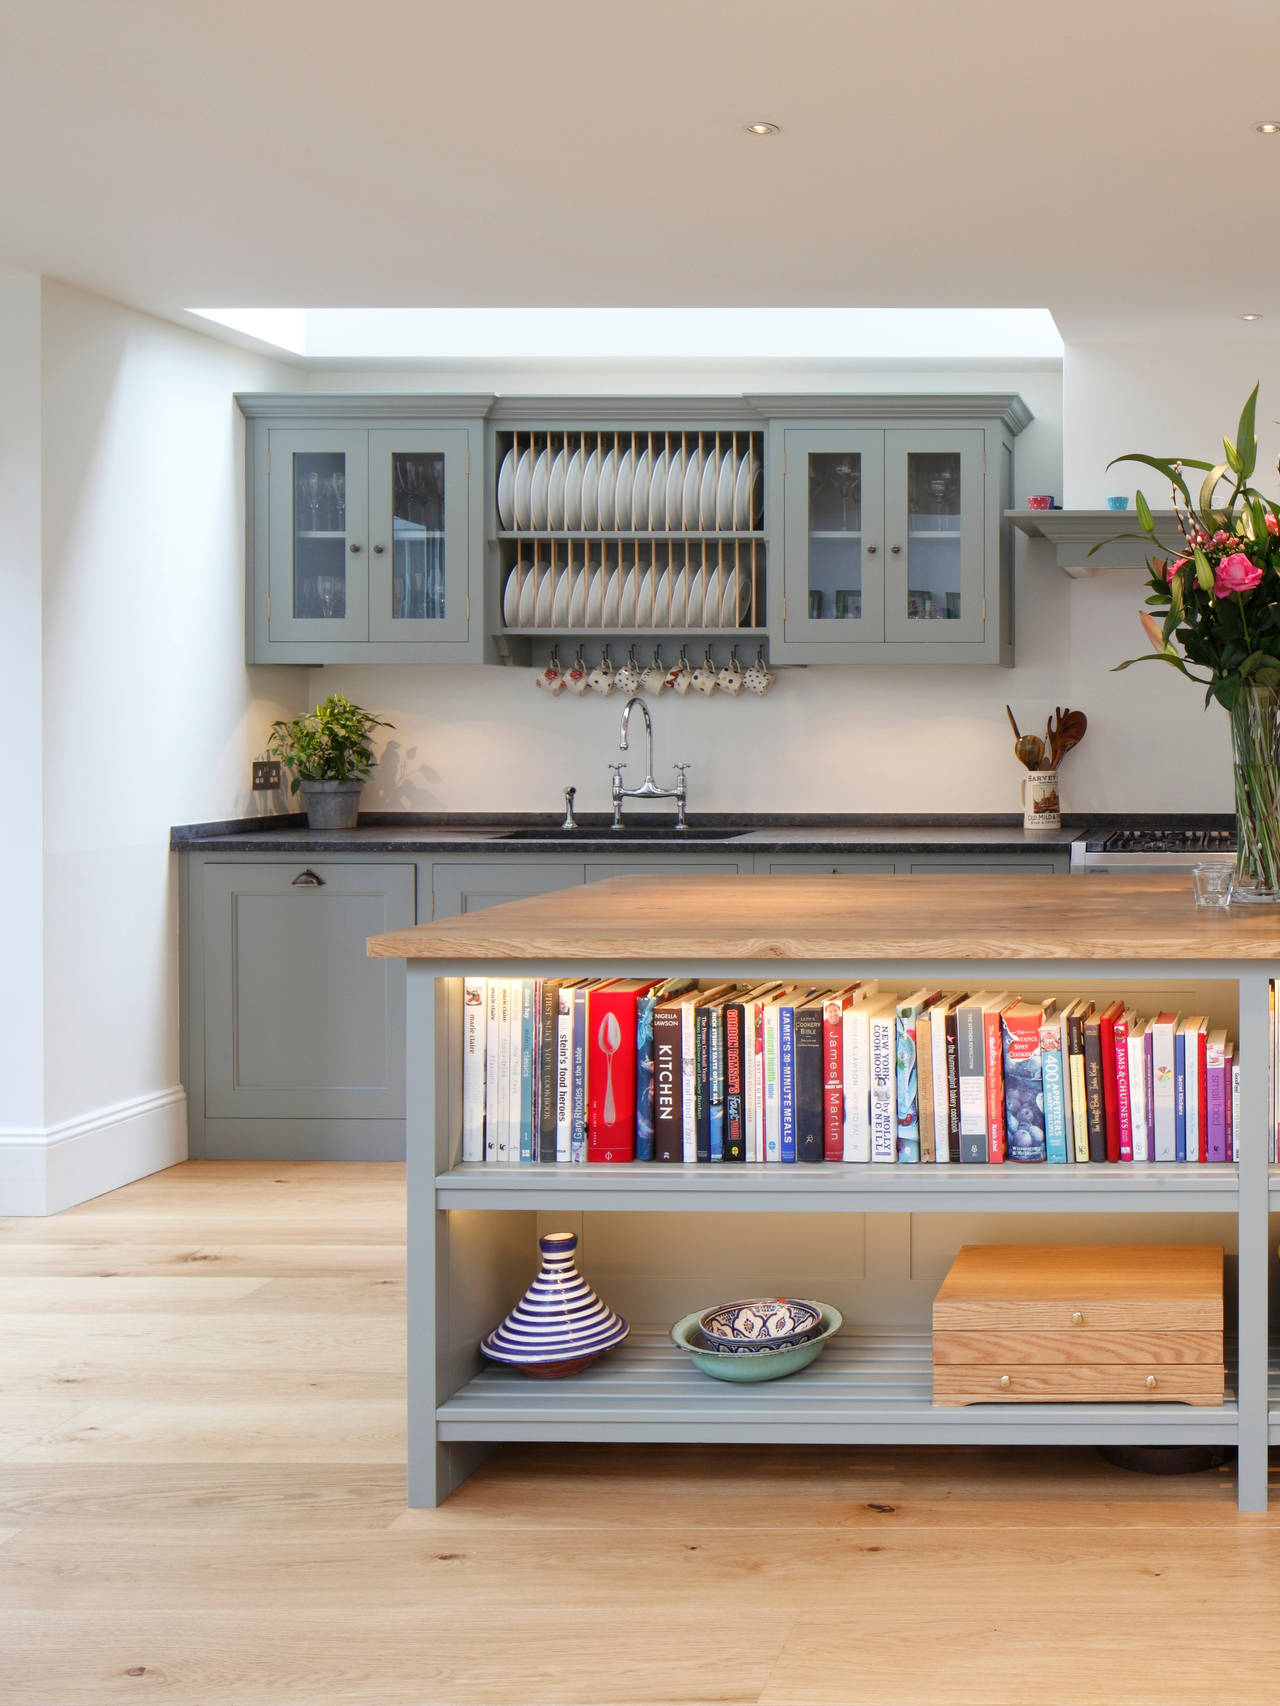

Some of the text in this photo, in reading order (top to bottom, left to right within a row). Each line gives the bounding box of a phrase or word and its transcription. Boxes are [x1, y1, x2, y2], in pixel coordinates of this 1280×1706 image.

[523, 1008, 531, 1018] hay
[545, 993, 553, 1016] FIRST
[468, 1014, 477, 1031] marie
[468, 1032, 477, 1055] claire
[728, 1009, 740, 1094] GORDON RAMSAY'S
[829, 1031, 837, 1081] James
[874, 1025, 882, 1080] COOKBOOK
[882, 1026, 890, 1080] NEW YORK
[1116, 1047, 1125, 1070] JAMS
[523, 1051, 531, 1078] classics
[559, 1034, 568, 1122] stein's food heroes
[712, 1070, 718, 1079] OF
[782, 1011, 792, 1143] JAMIE'S 30-MINUTE MEALS
[1045, 1056, 1057, 1081] 400
[1116, 1070, 1126, 1078] &
[659, 1044, 673, 1119] KITCHEN
[684, 1079, 692, 1097] real
[545, 1075, 553, 1120] COOKBOOK
[574, 1088, 583, 1118] Rhodes
[684, 1099, 692, 1118] food
[949, 1089, 957, 1107] bakery
[1053, 1084, 1062, 1136] APPETIZERS
[1118, 1078, 1128, 1128] CHUTNEYS
[1212, 1074, 1223, 1125] small food
[573, 1119, 585, 1139] Gary
[830, 1093, 841, 1141] Martin
[852, 1112, 860, 1121] TO
[875, 1102, 883, 1151] O'NEILL
[882, 1102, 891, 1150] by MOLLY
